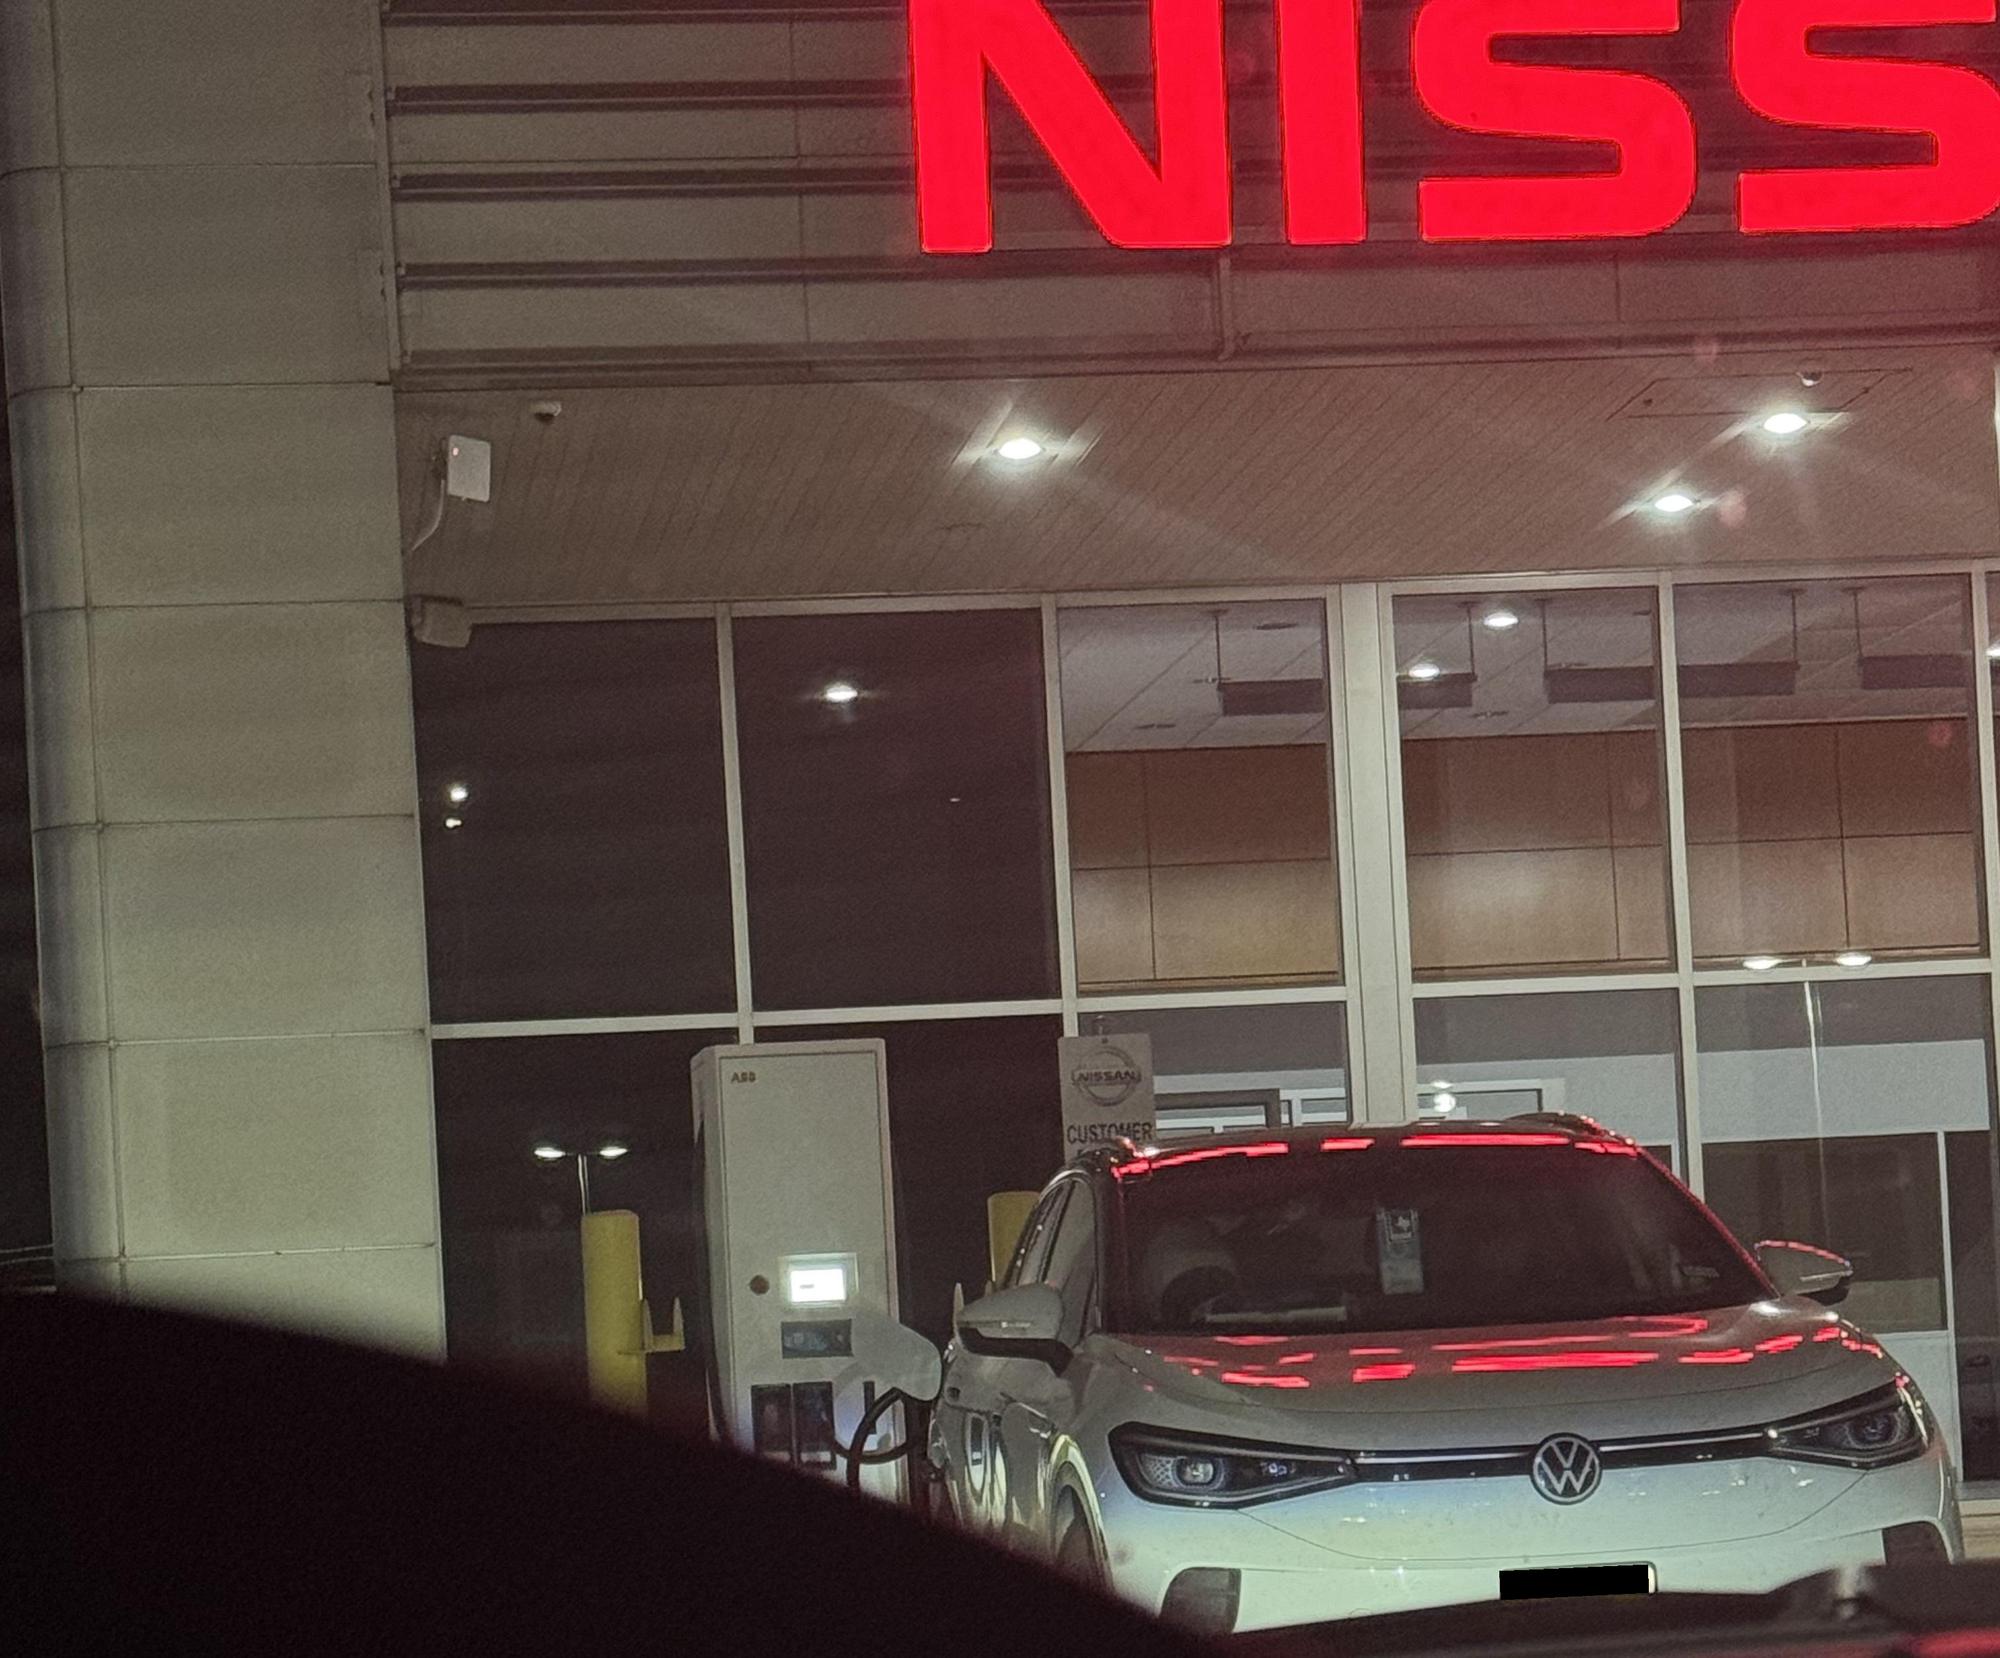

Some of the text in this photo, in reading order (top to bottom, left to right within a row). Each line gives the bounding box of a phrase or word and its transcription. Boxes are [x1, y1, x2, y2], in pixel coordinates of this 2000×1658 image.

[911, 0, 2000, 254] NISS
[1080, 1070, 1136, 1083] NISSAN
[1066, 1122, 1153, 1144] CUSTOMER
[1535, 1438, 1598, 1498] VW
